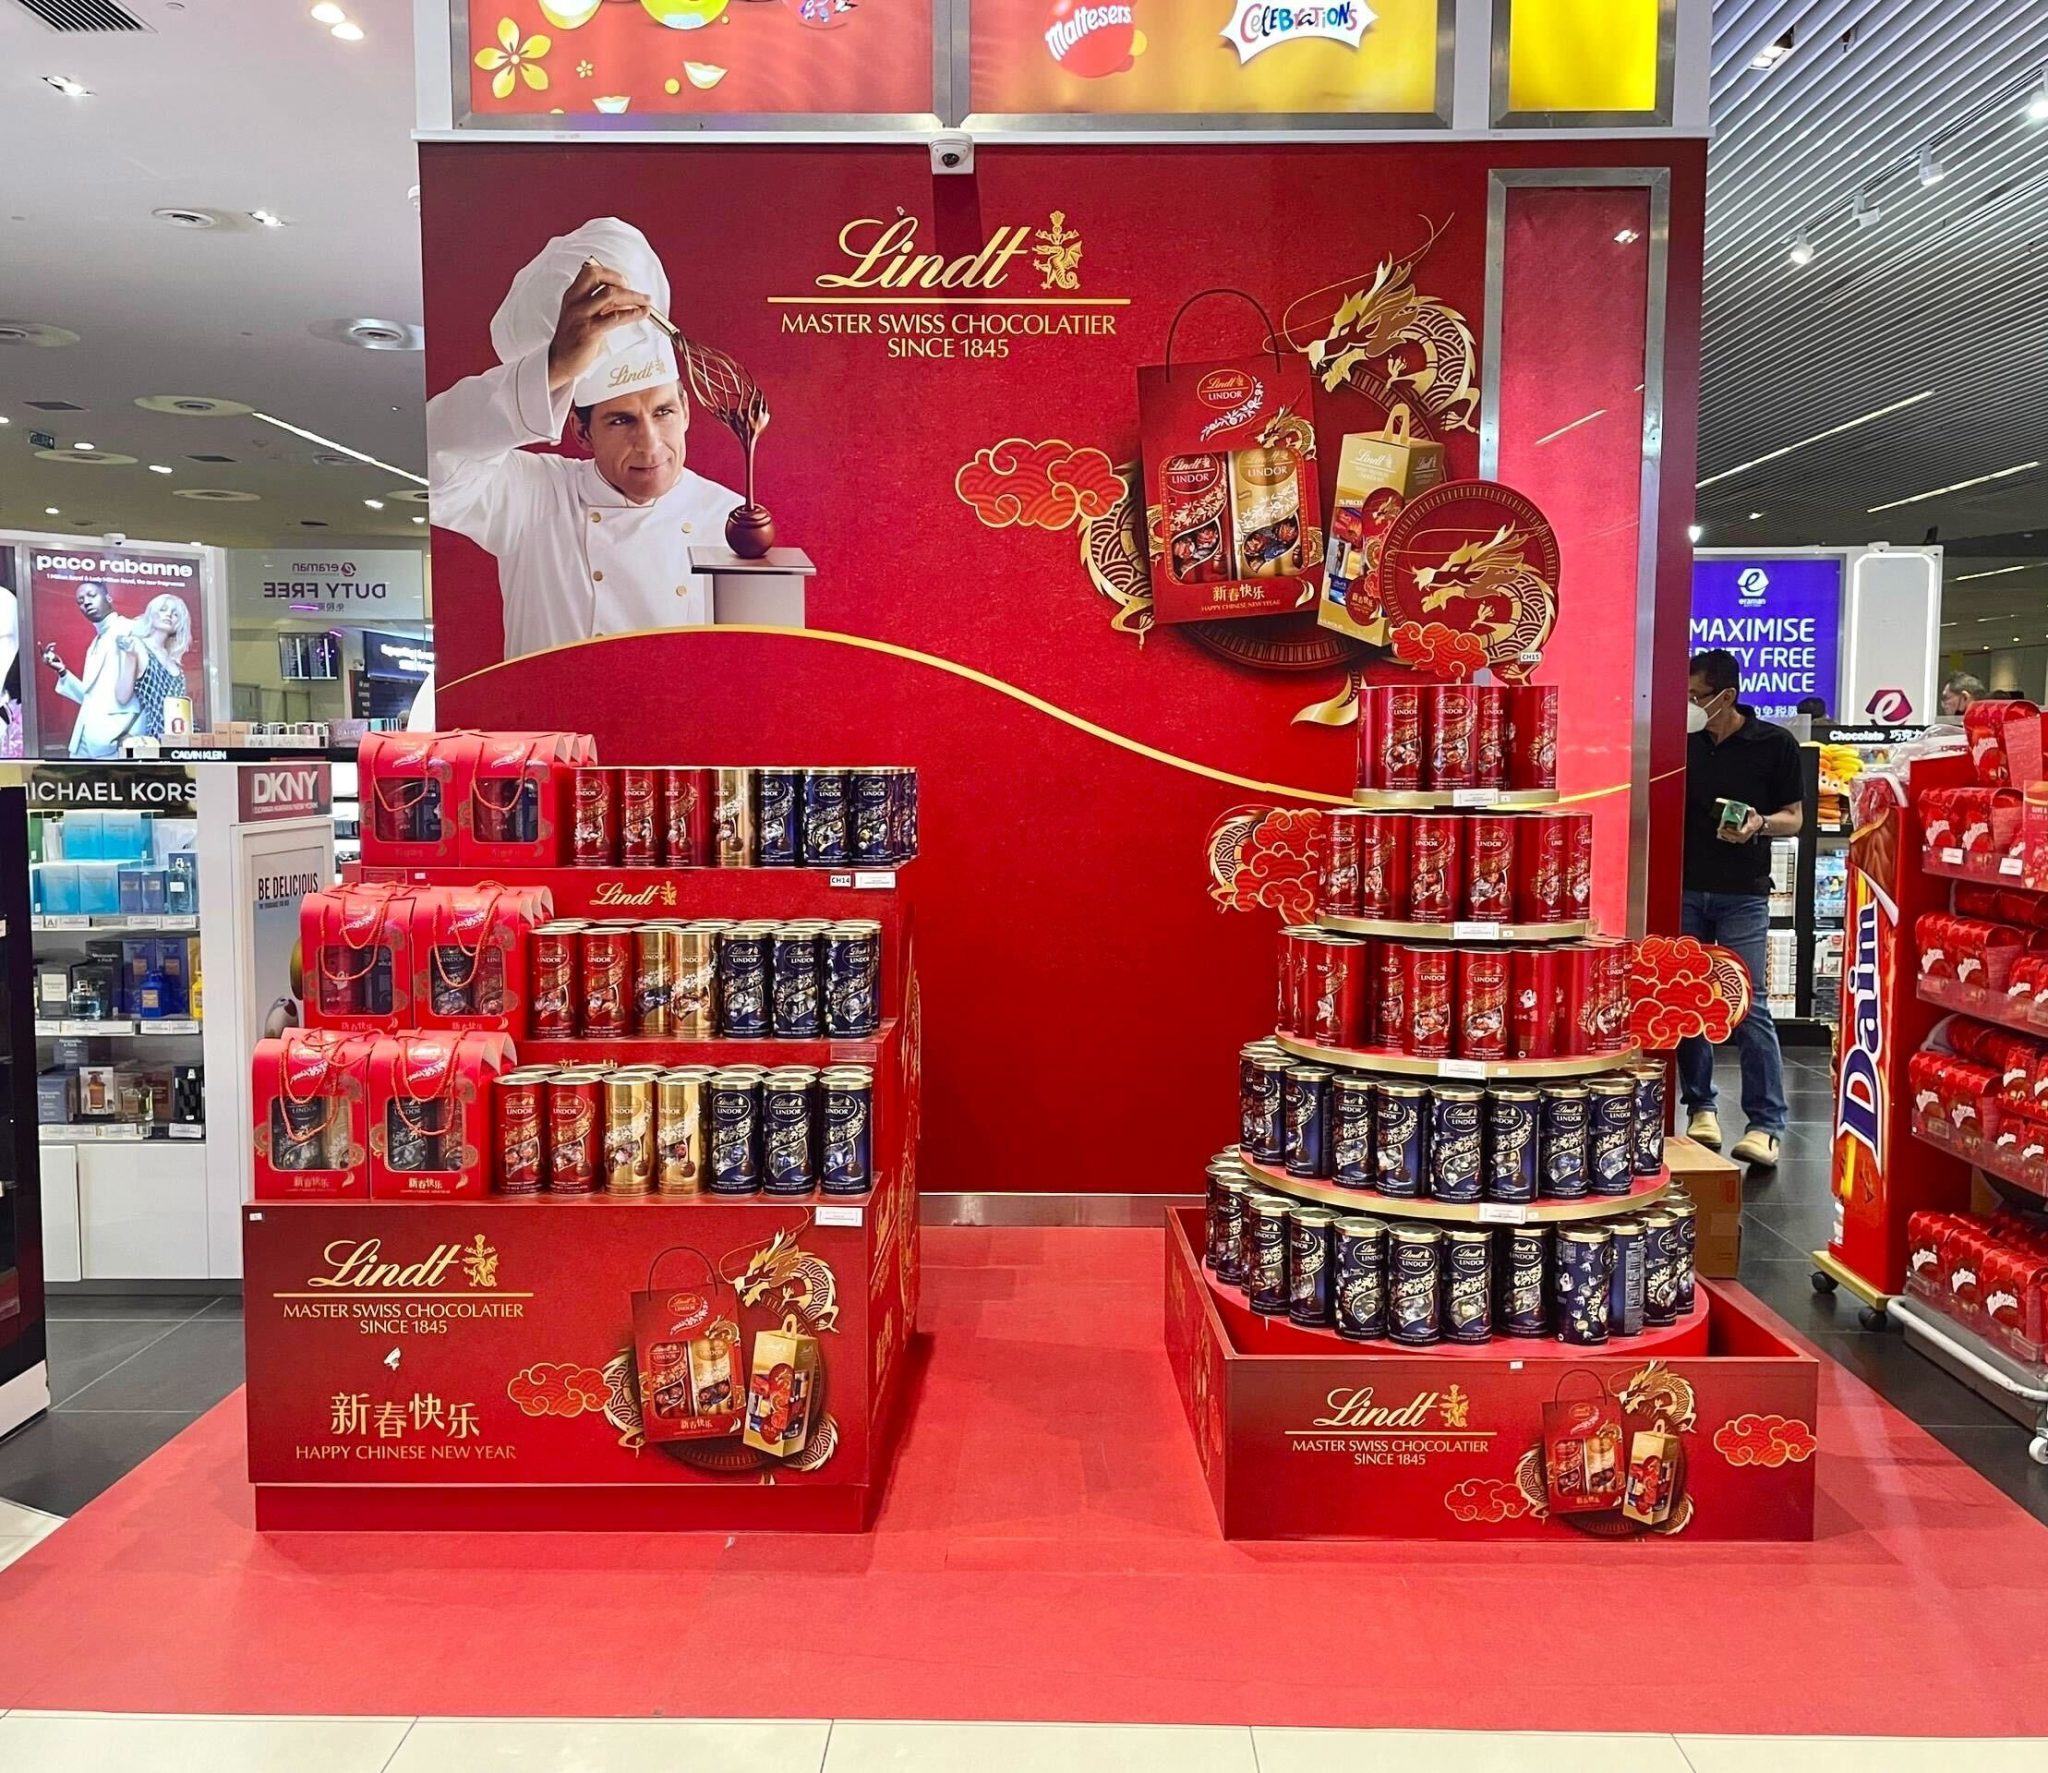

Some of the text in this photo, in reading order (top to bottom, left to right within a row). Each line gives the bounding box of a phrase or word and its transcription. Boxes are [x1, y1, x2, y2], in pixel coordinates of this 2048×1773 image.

[1044, 5, 1133, 61] Maltesers
[815, 215, 1031, 289] Lindt
[780, 313, 1116, 335] MASTER SWISS CHOCOLATIER
[887, 338, 1009, 359] SINCE 1845
[607, 360, 654, 389] Lindt
[1208, 391, 1242, 401] LINDOR
[1171, 473, 1209, 484] LINDOR
[1247, 465, 1288, 478] LINDOR
[36, 555, 193, 578] paco rabanne
[1212, 583, 1265, 602] 新春快乐
[1689, 617, 1816, 643] MAXIMISE
[1759, 647, 1816, 669] FREE
[1829, 729, 1886, 742] Chocolate
[170, 750, 227, 760] CALVIN KLEIN
[25, 782, 197, 801] ICHAEL KORS
[253, 771, 319, 804] DKNY
[258, 872, 319, 901] BE DELICIOUS
[831, 876, 850, 884] CH14
[589, 882, 661, 906] Lindt
[1836, 897, 1882, 1176] Daim
[506, 1107, 533, 1115] LINDOR
[775, 1108, 801, 1116] LINDOR
[1451, 1118, 1477, 1126] LINDOR
[307, 1238, 462, 1288] Lindt
[1402, 1259, 1429, 1268] LINDOR
[1459, 1259, 1485, 1267] LINDOR
[283, 1303, 524, 1318] MASTER SWISS CHOCOLATIER
[359, 1319, 448, 1334] SINCE 1845
[330, 1391, 481, 1439] 新春快乐
[1312, 1386, 1439, 1427] Lindt
[296, 1445, 517, 1460] HAPPY CHINESE NEW YEAR
[1292, 1439, 1489, 1453] MASTER SWISS CHOCOLATIER
[1354, 1453, 1426, 1466] SINCE 1845
